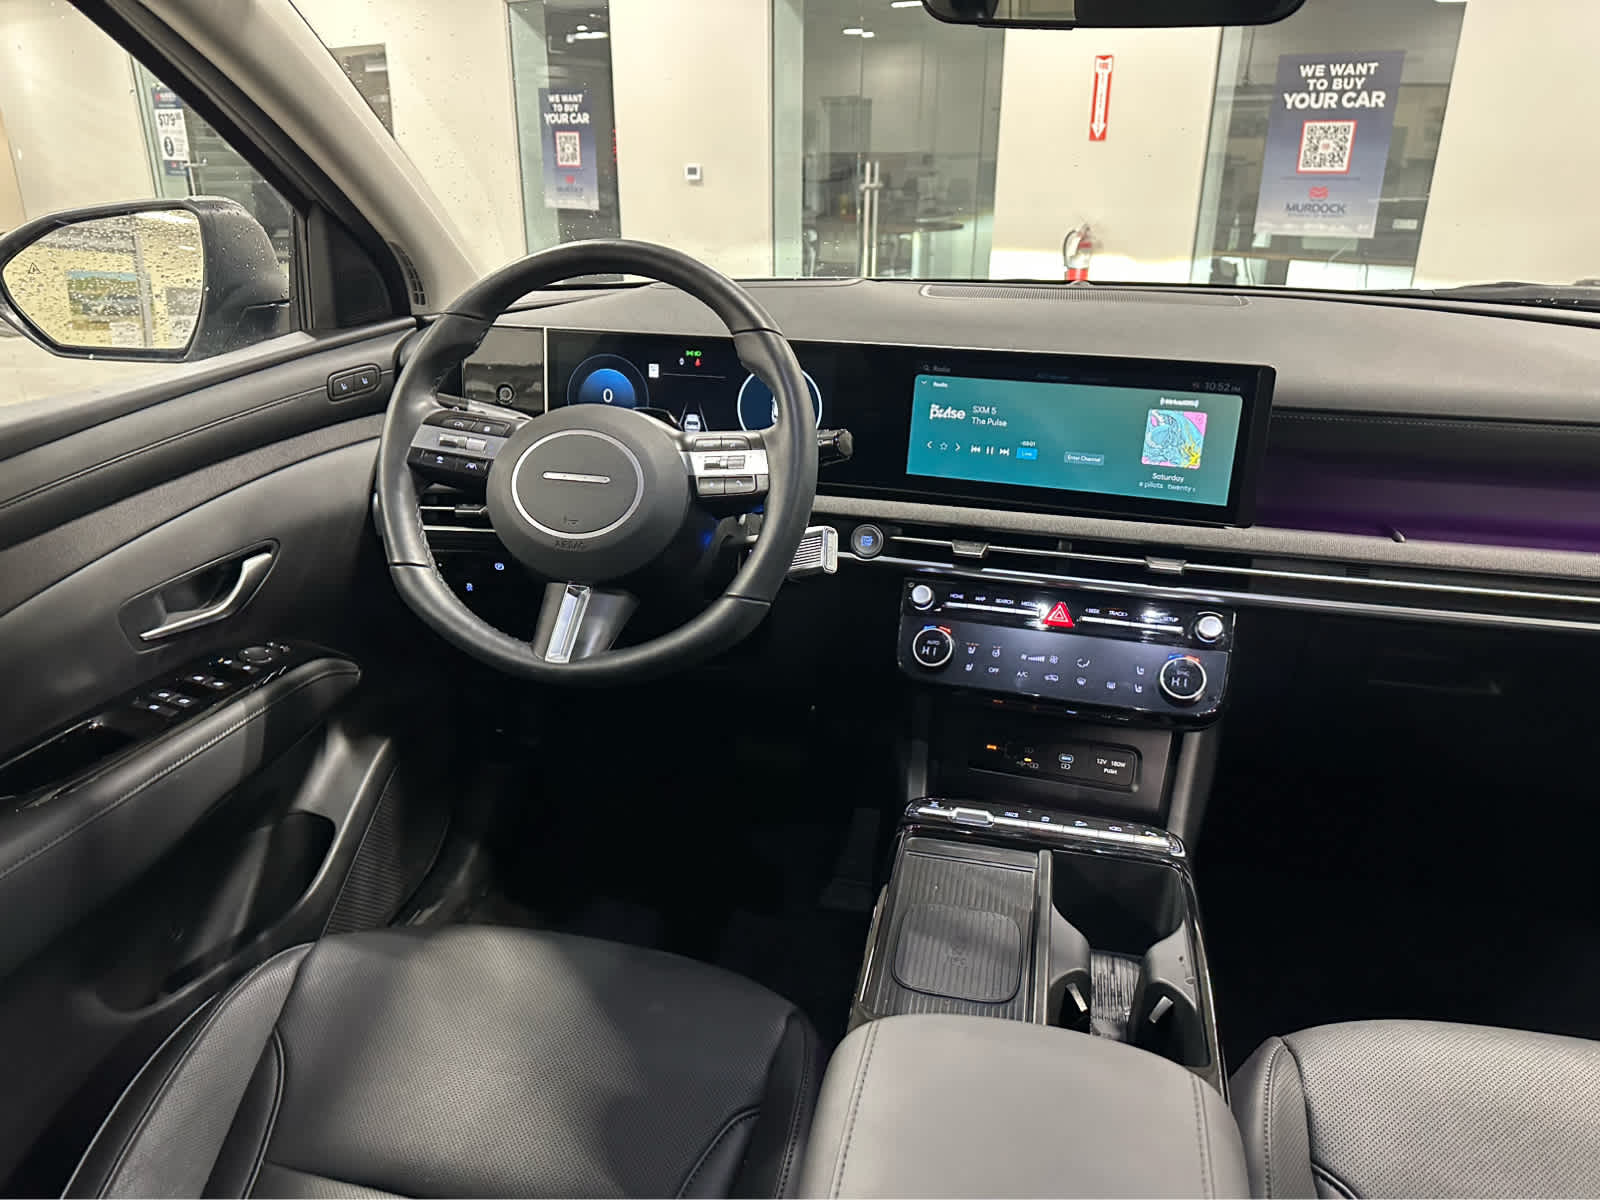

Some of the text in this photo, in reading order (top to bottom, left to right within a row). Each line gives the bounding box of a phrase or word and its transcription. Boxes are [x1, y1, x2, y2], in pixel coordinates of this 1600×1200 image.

[1300, 62, 1379, 77] WE WANT
[1307, 77, 1366, 91] TO BUY
[548, 94, 583, 103] WE WANT
[1283, 91, 1386, 109] YOUR CAR
[552, 103, 579, 112] TO BUY
[544, 113, 590, 124] YOUR CAR
[1285, 203, 1345, 214] MURDOCK
[602, 388, 614, 403] 0
[972, 405, 997, 415] SXM 5
[972, 416, 1008, 427] The Pulse
[1152, 472, 1184, 483] Saturday
[1167, 483, 1192, 493] twenty
